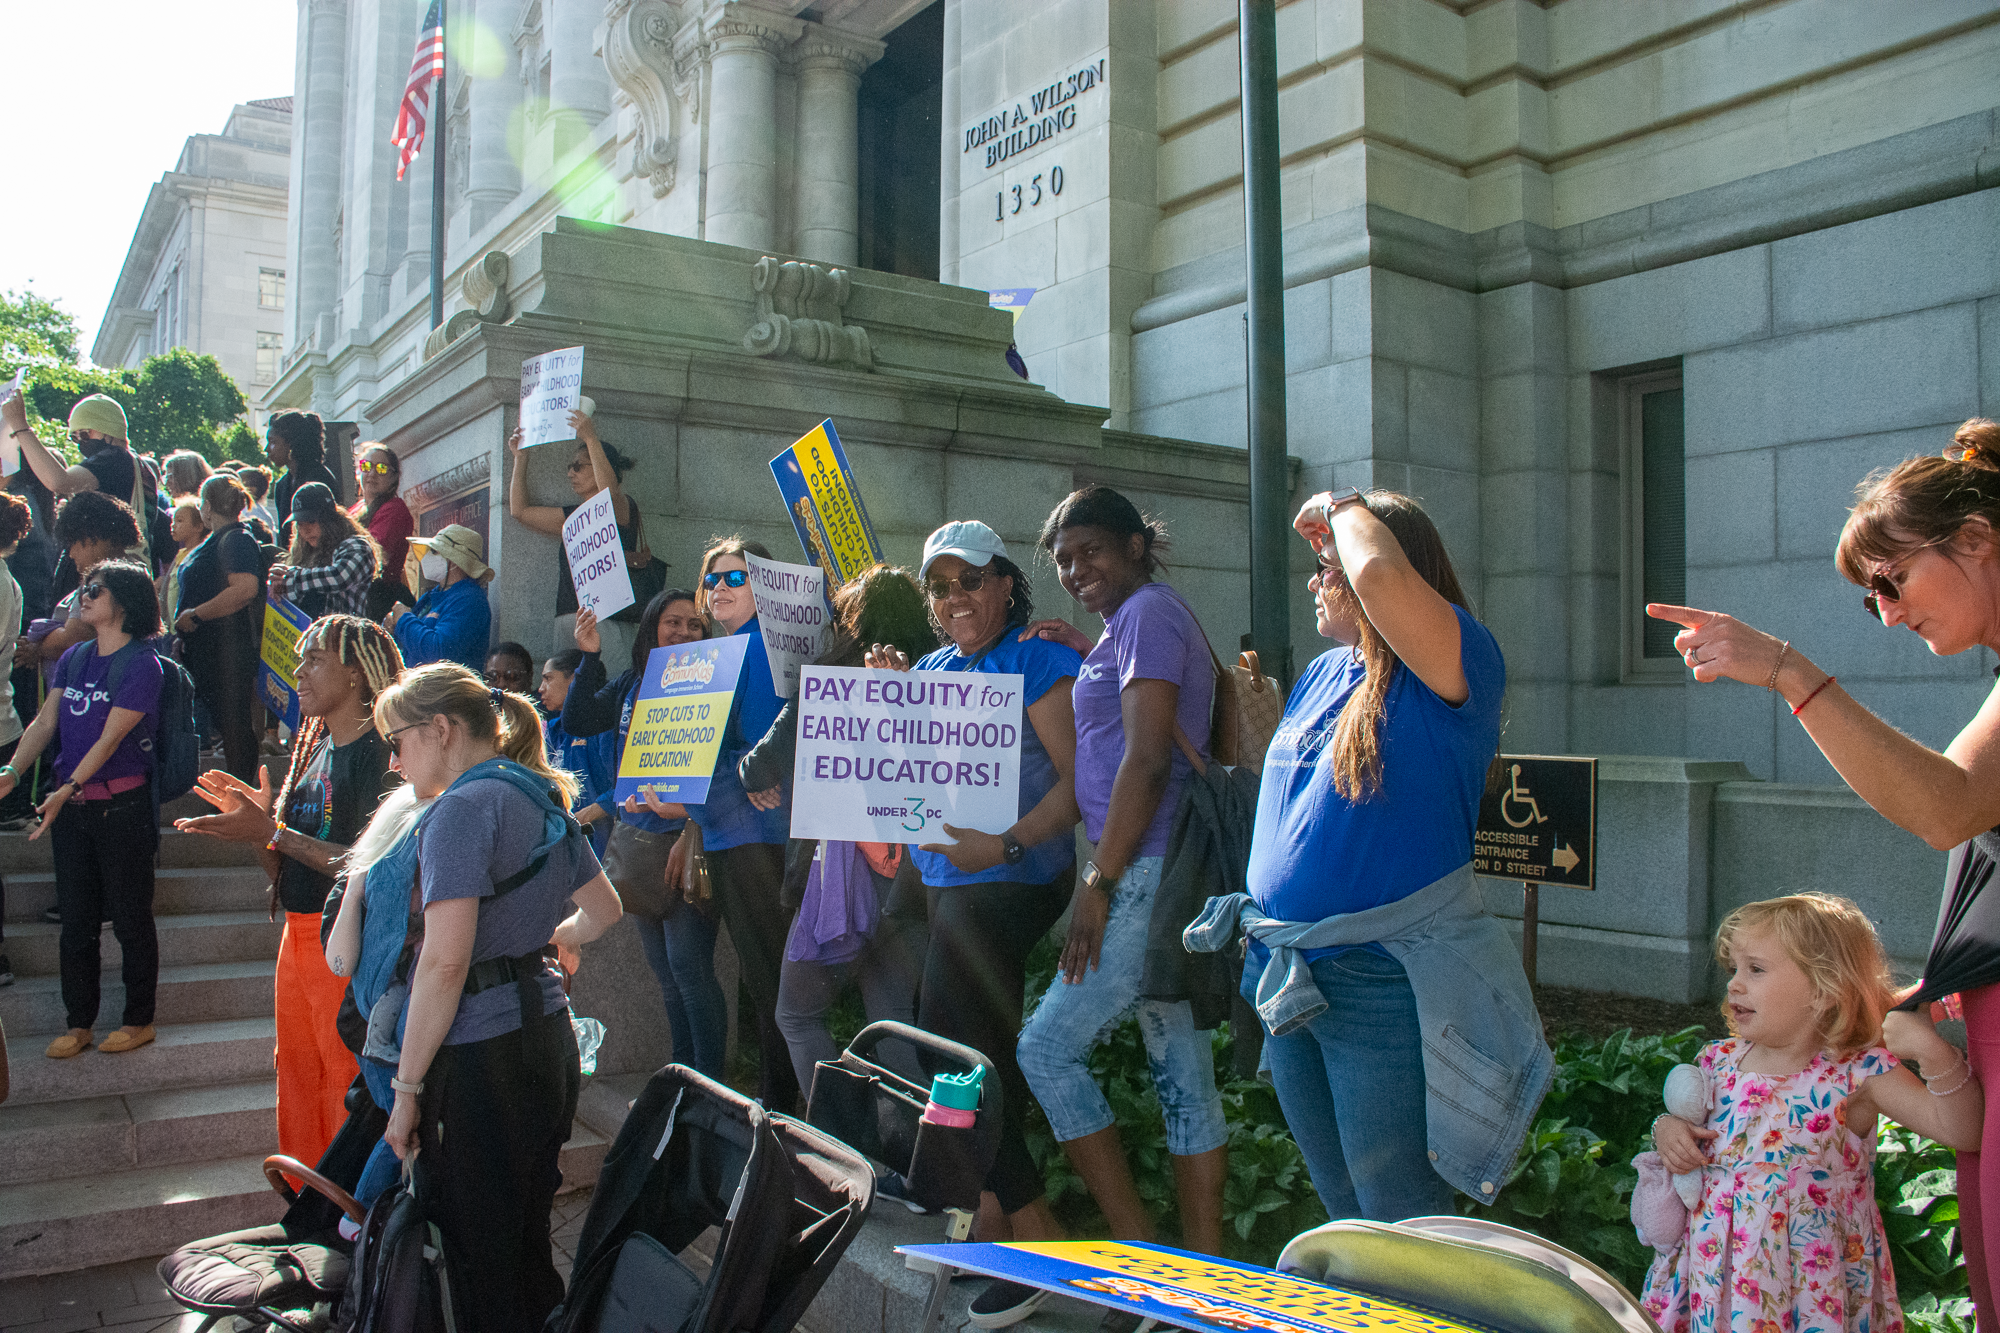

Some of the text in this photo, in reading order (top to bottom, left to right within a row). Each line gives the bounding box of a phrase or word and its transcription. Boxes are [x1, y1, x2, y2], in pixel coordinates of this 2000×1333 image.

[964, 58, 1105, 153] JOHN A WILSON
[985, 103, 1076, 169] BUILDING
[522, 354, 581, 379] PAY EQUITY for
[536, 374, 580, 394] CHILDHOOD
[522, 395, 573, 418] EDUCATORS!
[810, 447, 855, 552] CHILDHOOD
[565, 501, 609, 546] QUITY for
[810, 473, 854, 577] OP CUTS TO
[569, 523, 617, 569] CHILDHOOD
[748, 562, 820, 594] PAY EQUITY for
[771, 600, 822, 625] CHILDHOOD
[765, 628, 815, 656] EDUCATORS!
[661, 657, 715, 689] CommuniKids
[1078, 663, 1103, 683] DC
[804, 676, 1016, 708] PAY EQUITY for
[645, 707, 670, 724] STOP
[670, 704, 695, 723] CUTS
[696, 703, 711, 721] TO
[631, 726, 716, 747] EARLY CHILDHOOD
[802, 715, 1017, 748] EARLY CHILDHOOD
[638, 750, 694, 768] EDUCATION!
[814, 755, 1001, 787] EDUCATORS!
[866, 797, 942, 832] UNDER 3 DC
[1474, 830, 1539, 847] ACCESSIBLE
[1474, 845, 1530, 860] ENTRANCE
[1473, 858, 1548, 877] ON D STREET
[1118, 1265, 1190, 1283] TO
[1211, 1286, 1370, 1328] CUTS
